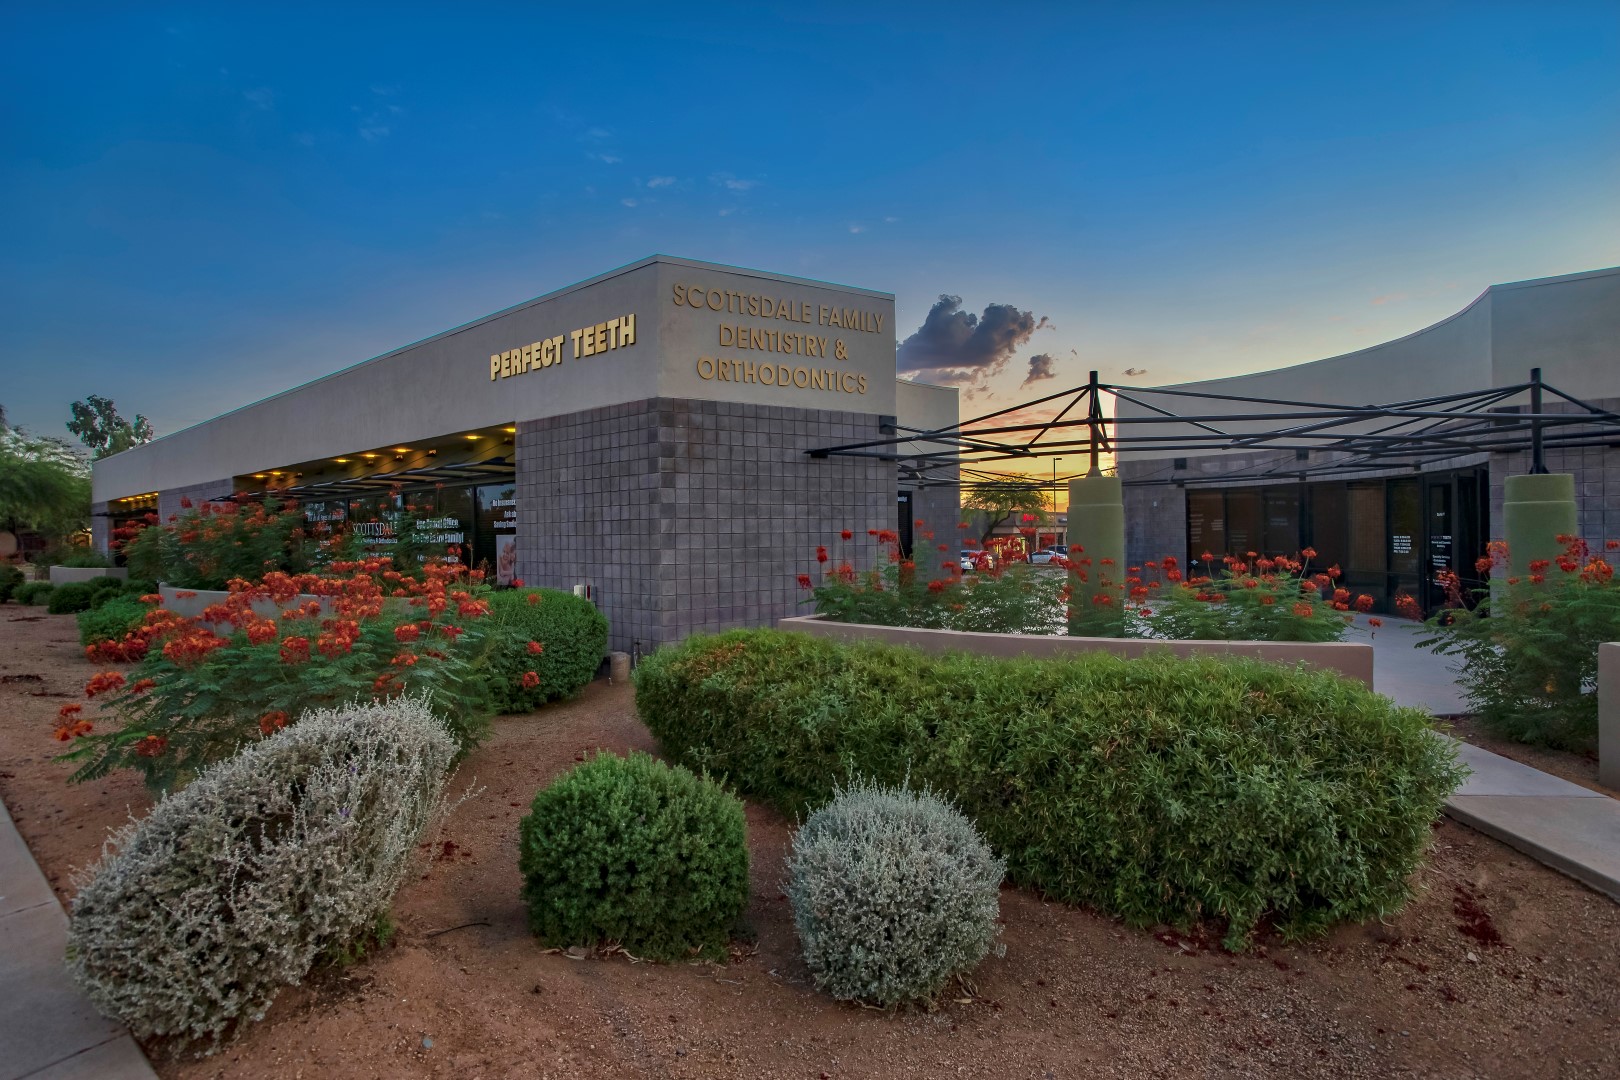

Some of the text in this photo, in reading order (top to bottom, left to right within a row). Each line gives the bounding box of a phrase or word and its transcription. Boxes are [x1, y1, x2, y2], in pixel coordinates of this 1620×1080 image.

[673, 283, 884, 333] SCOTTSDALE FAMILY
[490, 313, 636, 381] PERFECT TEETH
[720, 324, 848, 360] DENTISTRY &
[697, 357, 867, 394] ORTHODONTICS
